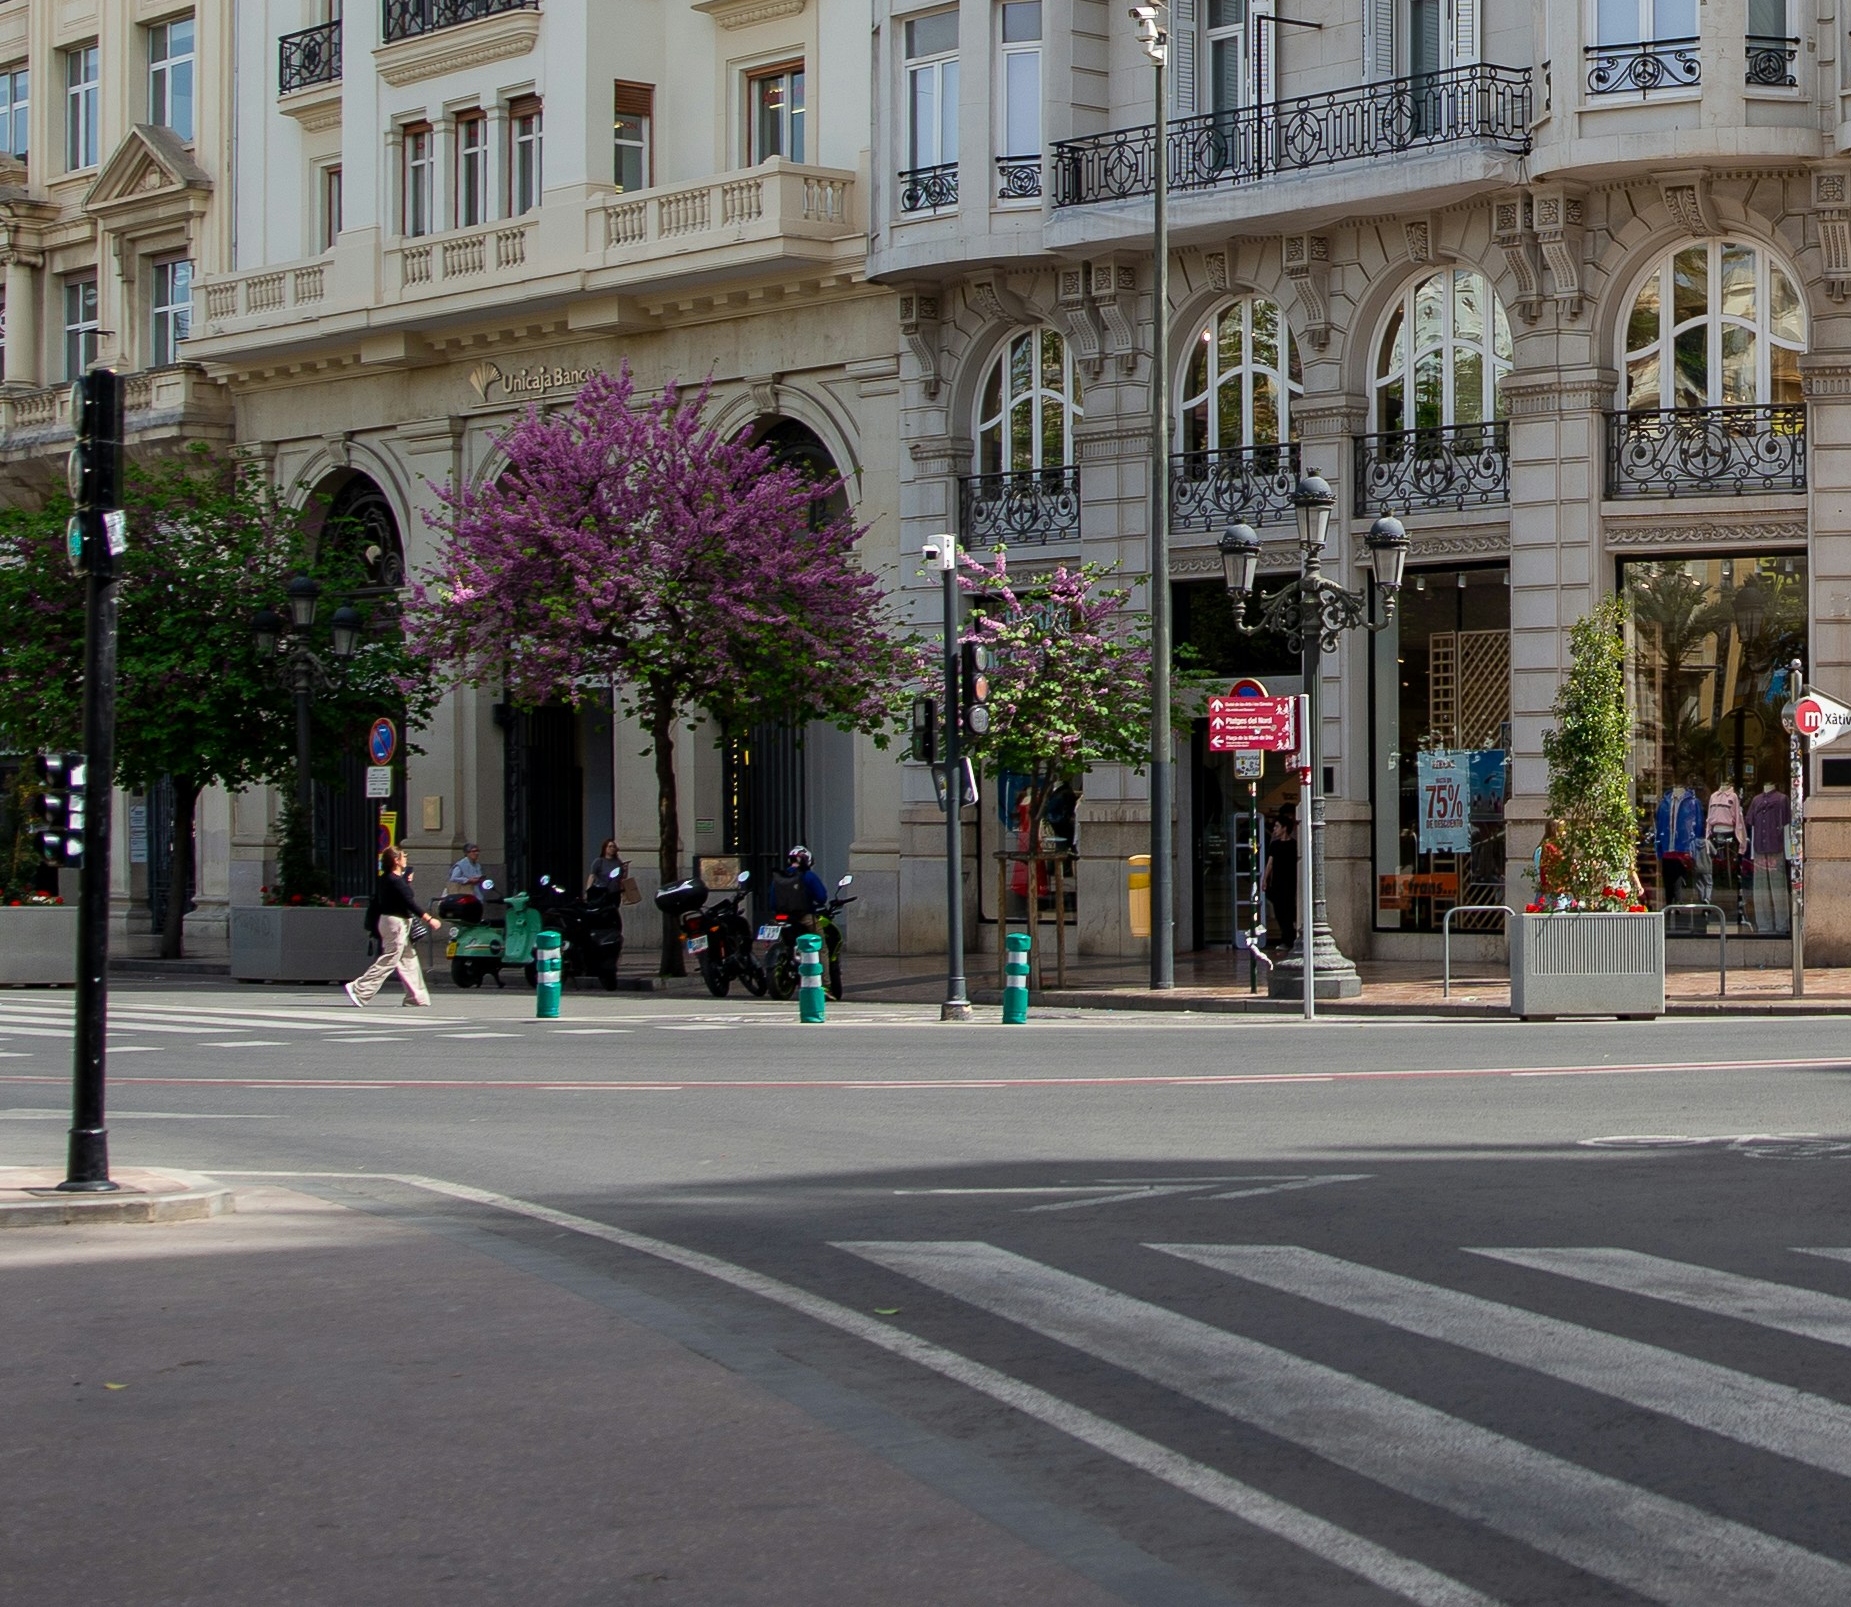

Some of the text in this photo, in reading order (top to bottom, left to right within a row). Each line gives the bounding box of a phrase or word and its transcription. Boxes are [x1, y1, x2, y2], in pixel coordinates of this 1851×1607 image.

[502, 366, 552, 393] Unicaja
[1425, 784, 1463, 819] 75%
[1426, 819, 1433, 829] DE
